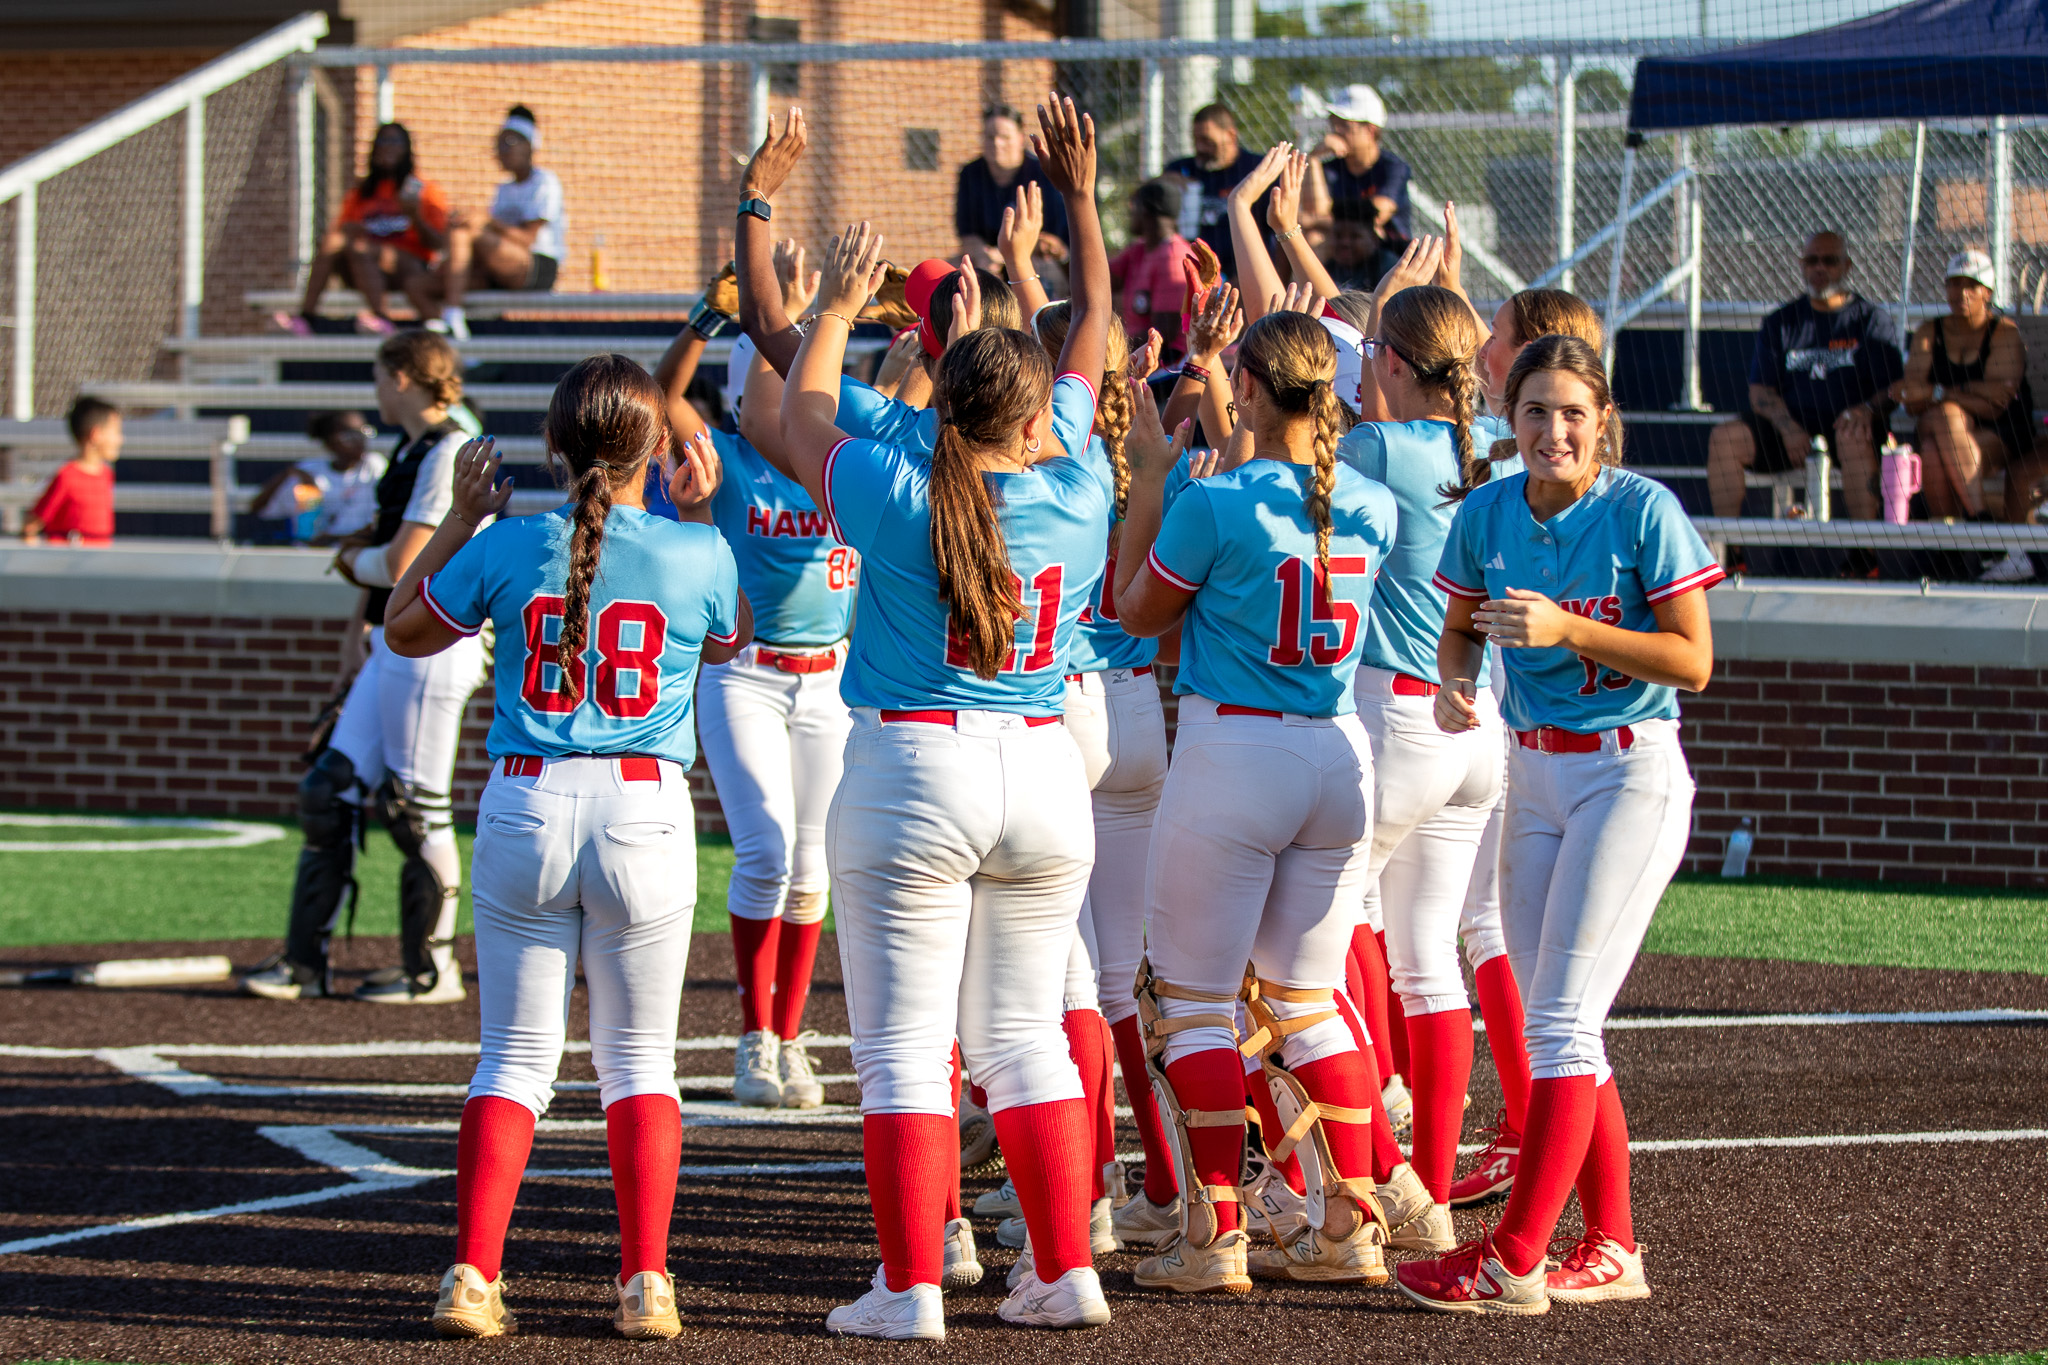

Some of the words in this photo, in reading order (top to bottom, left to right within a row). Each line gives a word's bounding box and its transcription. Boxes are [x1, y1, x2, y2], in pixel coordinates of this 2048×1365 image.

[747, 504, 833, 538] HAW
[520, 593, 669, 720] 88
[1267, 554, 1368, 667] 15
